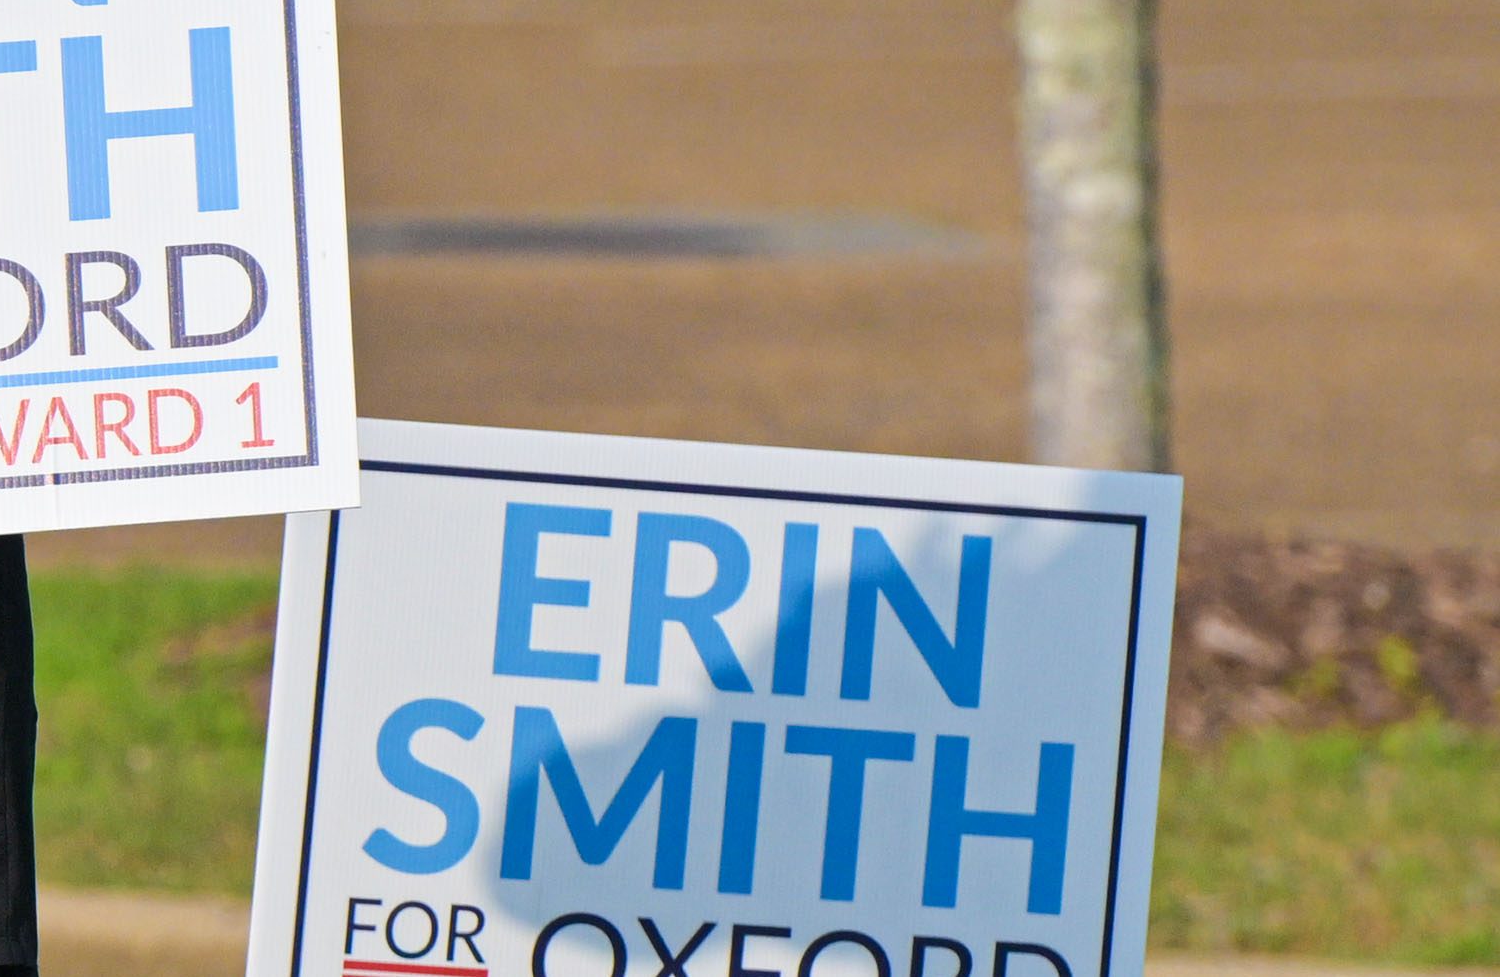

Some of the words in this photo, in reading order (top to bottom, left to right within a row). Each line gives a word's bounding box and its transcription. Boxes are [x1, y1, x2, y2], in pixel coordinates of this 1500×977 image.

[235, 381, 275, 449] 1
[493, 502, 994, 711] ERIN
[362, 698, 1076, 917] SMITH
[344, 897, 486, 963] FOR
